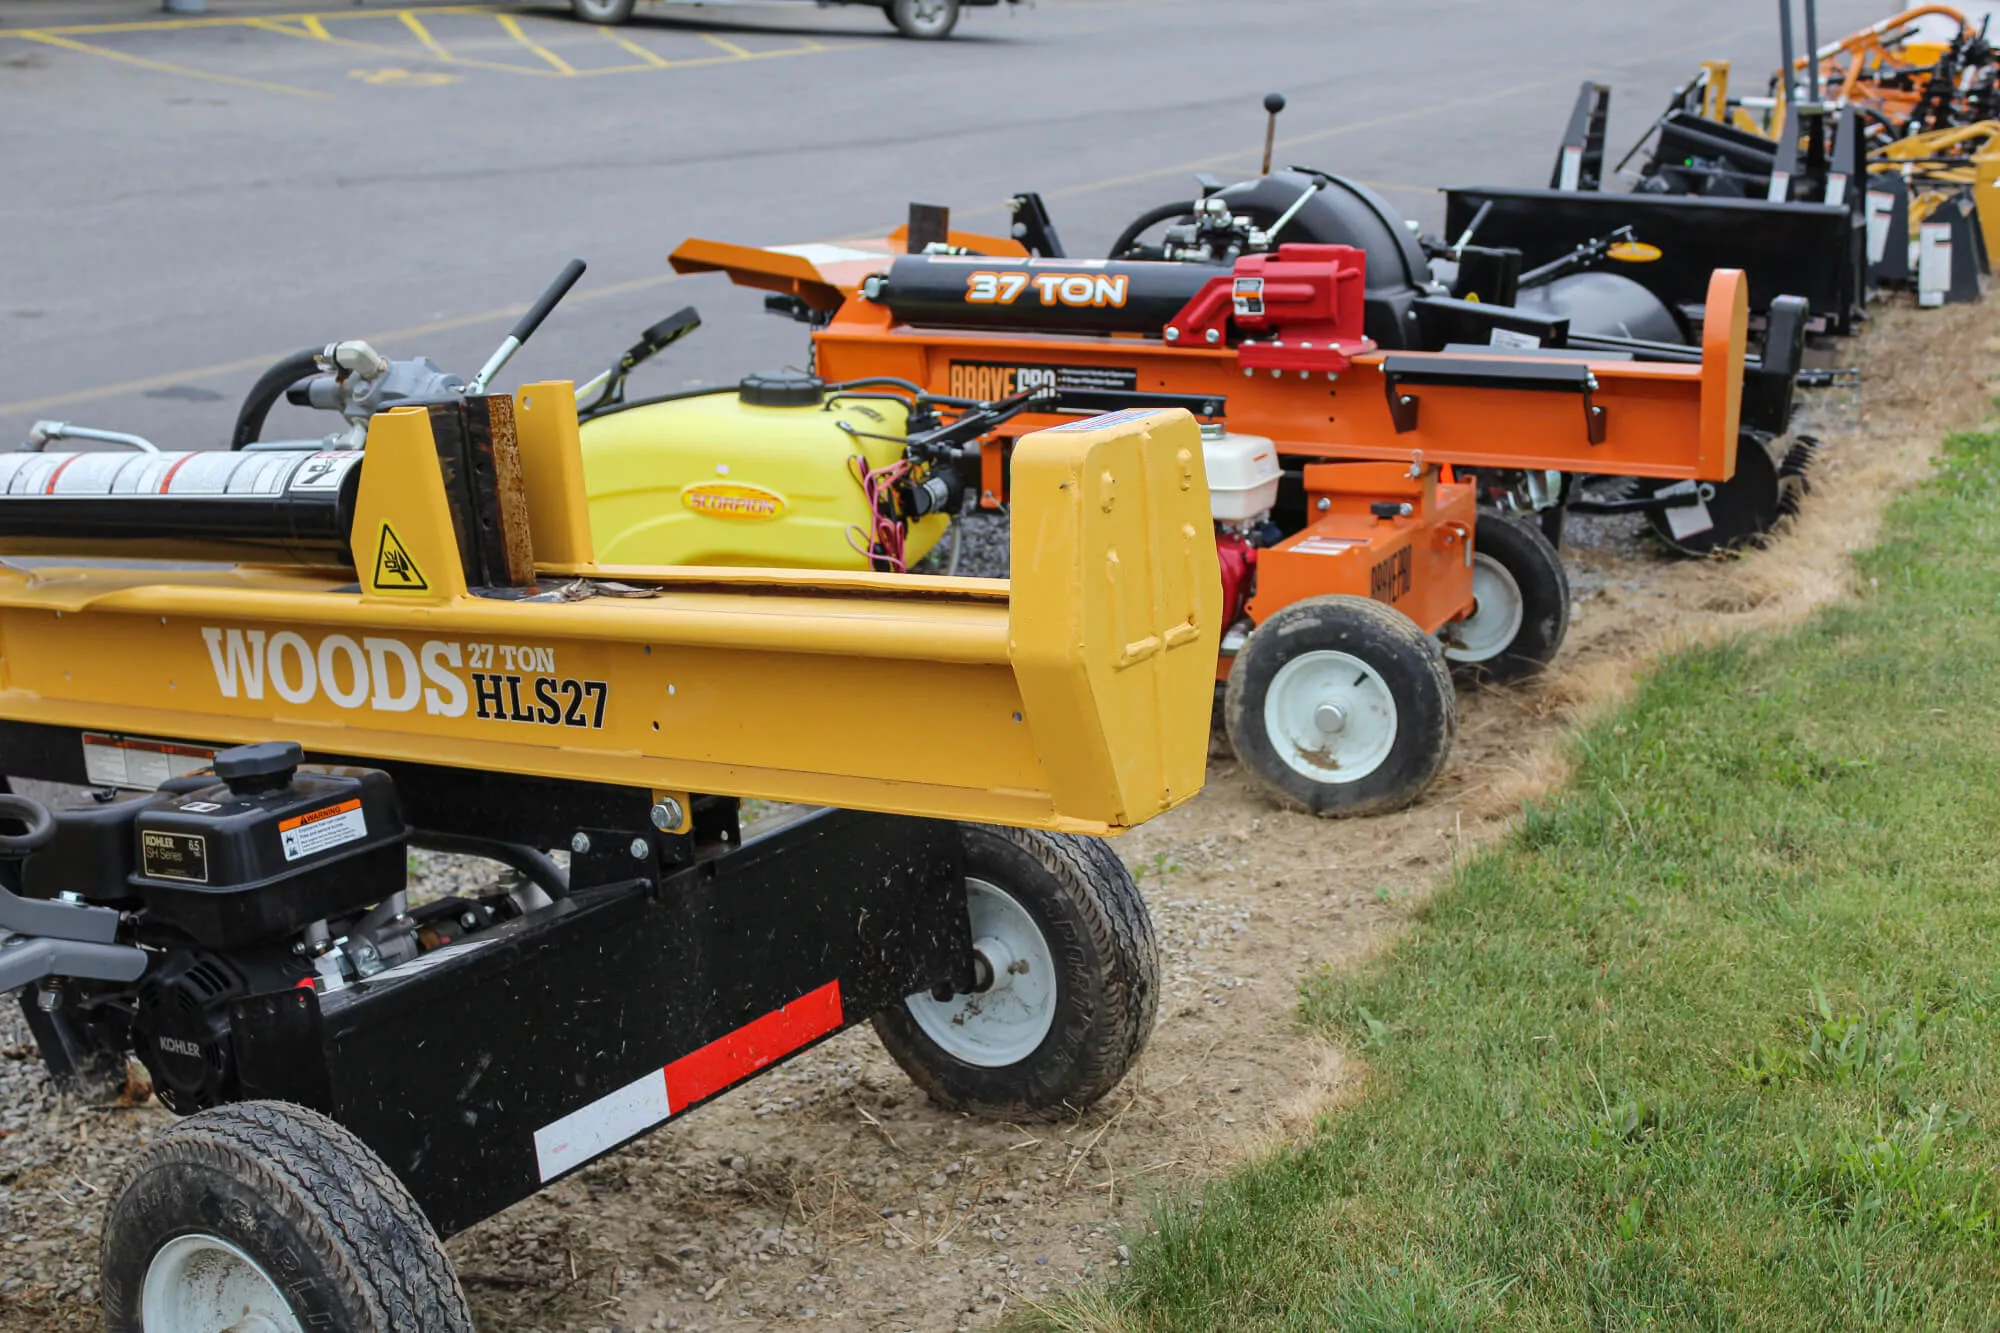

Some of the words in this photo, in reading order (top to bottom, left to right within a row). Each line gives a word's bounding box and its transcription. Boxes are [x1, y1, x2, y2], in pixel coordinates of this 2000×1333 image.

[966, 271, 1030, 304] 37
[1032, 273, 1129, 308] TON
[951, 364, 1016, 400] BRAVE
[690, 493, 776, 515] SCORPION
[201, 626, 469, 718] WOODS
[467, 642, 495, 670] 27
[500, 645, 555, 674] TON
[471, 673, 608, 729] HLS27
[307, 807, 341, 821] WARNING
[145, 835, 175, 849] KOHLER
[159, 1036, 202, 1059] KOHLER
